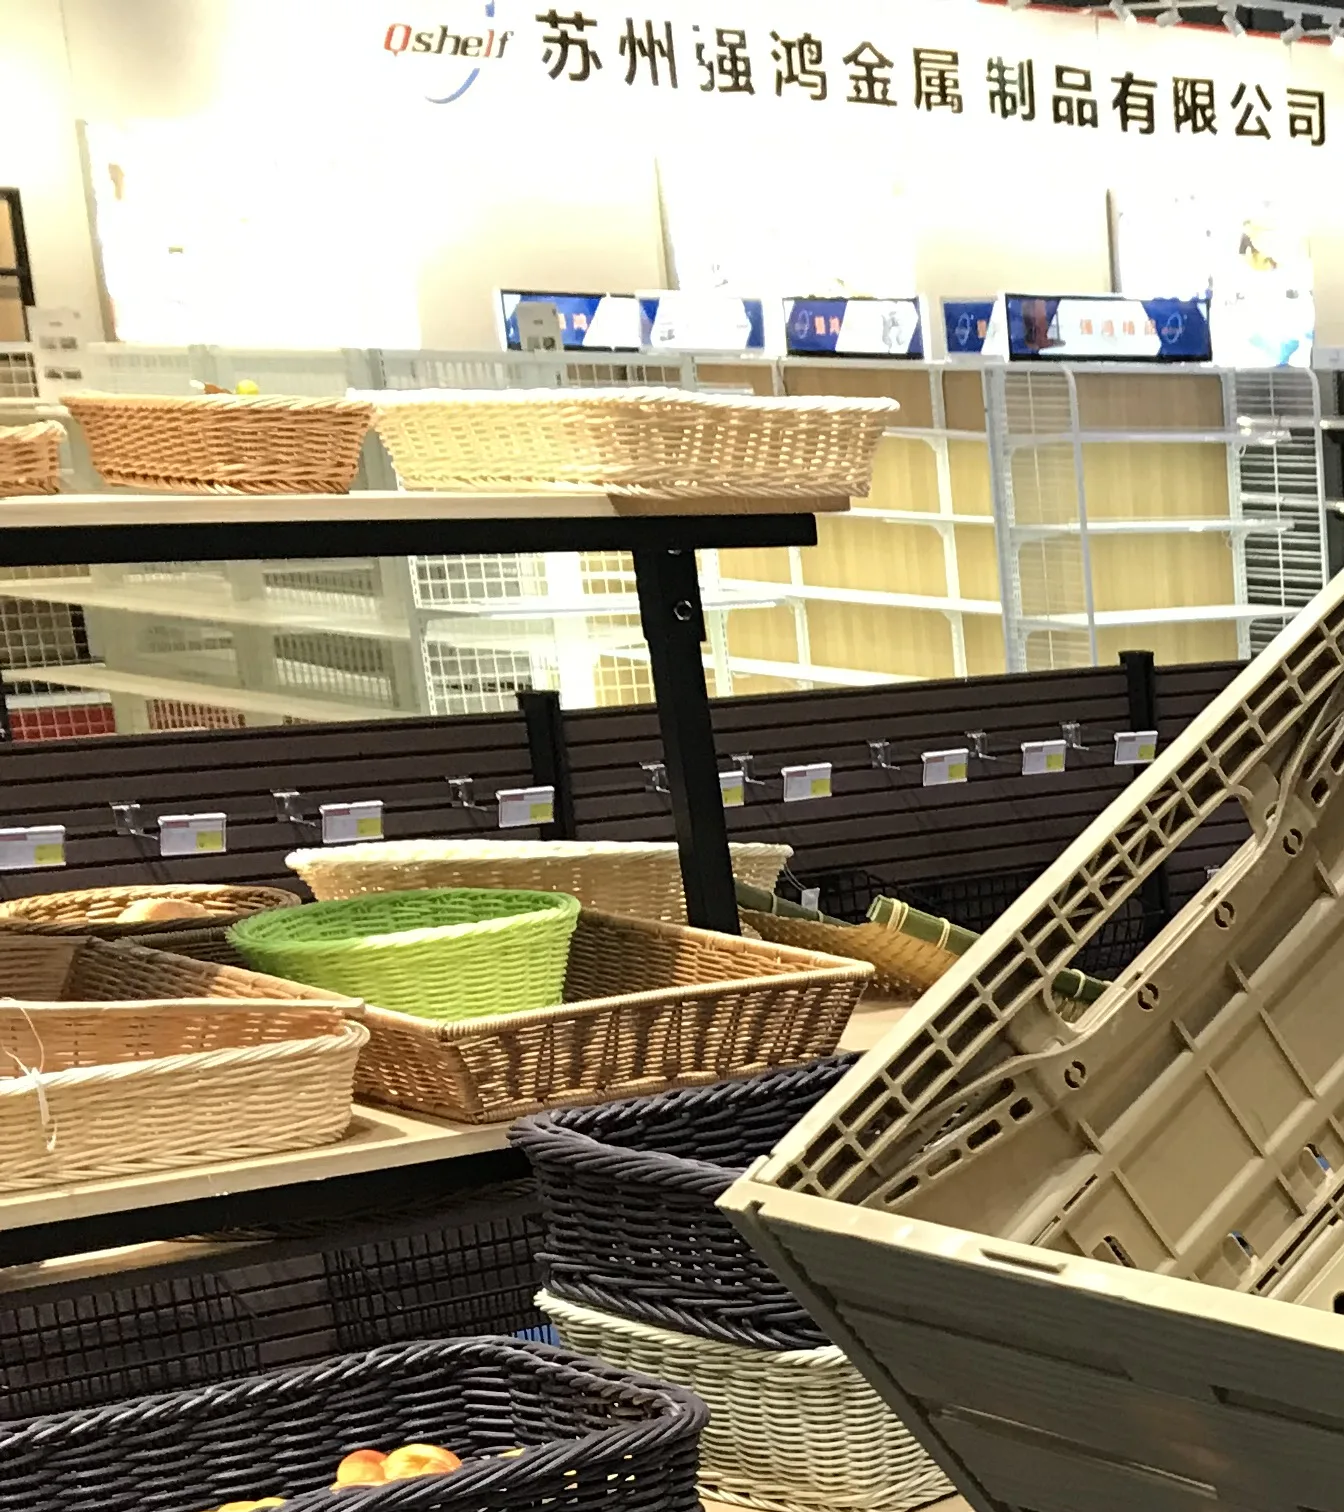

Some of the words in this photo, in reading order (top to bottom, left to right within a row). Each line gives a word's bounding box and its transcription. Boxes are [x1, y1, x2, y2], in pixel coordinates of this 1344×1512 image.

[382, 22, 514, 58] Qshelf
[535, 8, 1327, 148] 苏州强鸿金属制品有限公司
